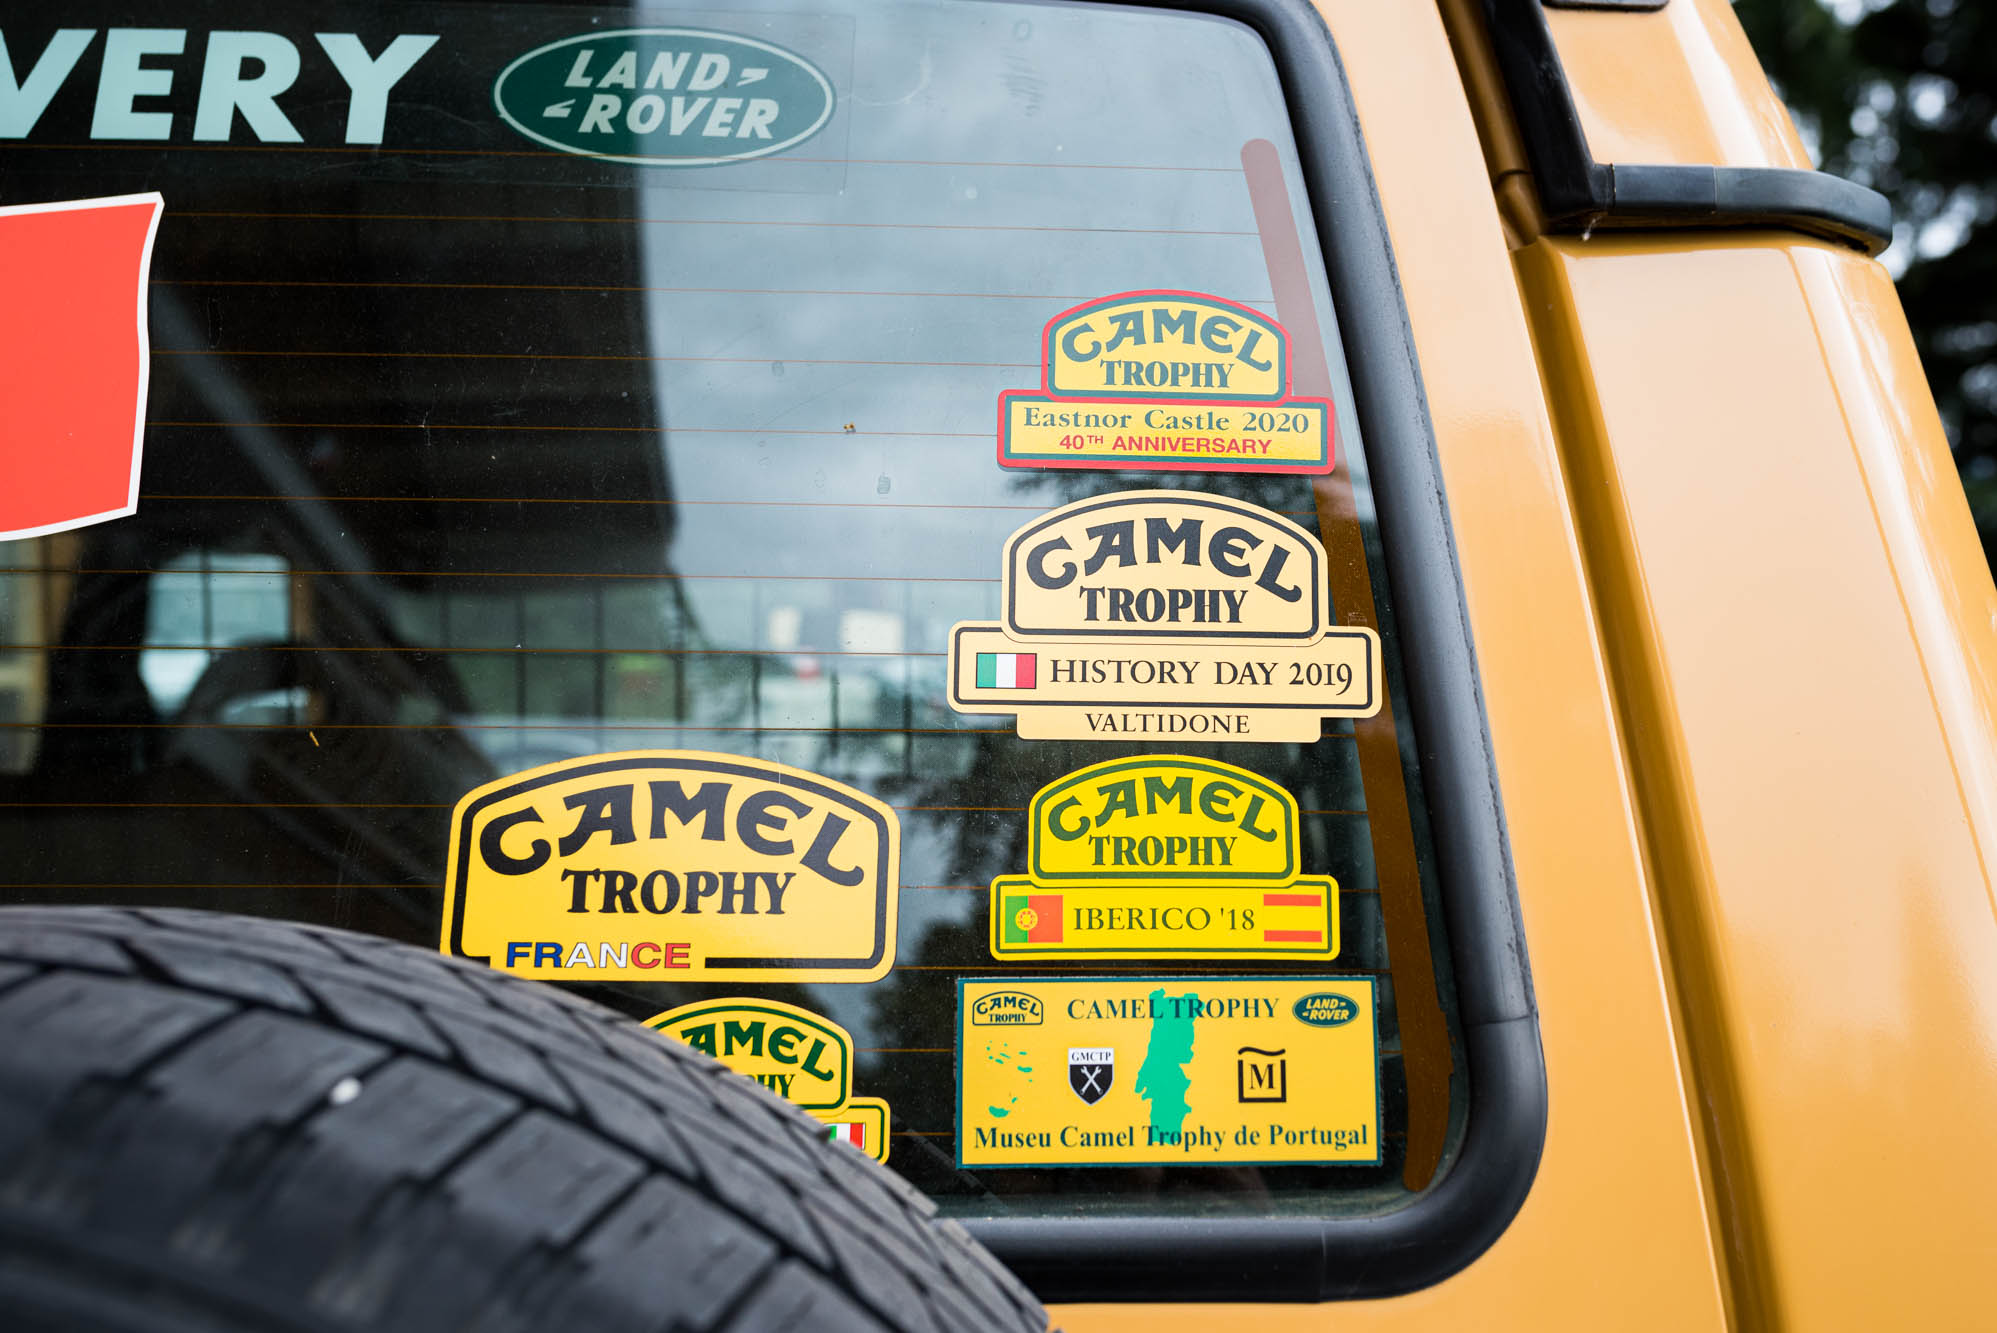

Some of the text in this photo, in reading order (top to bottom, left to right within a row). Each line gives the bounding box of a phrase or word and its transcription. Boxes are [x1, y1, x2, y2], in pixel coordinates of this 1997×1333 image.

[564, 49, 731, 91] LAND
[577, 94, 780, 140] ROVER
[1061, 308, 1273, 373] CAMEL
[1100, 359, 1235, 389] TROPHY
[1023, 406, 1309, 433] Eastnor Castle 2020
[1059, 434, 1272, 454] 40TH ANNIVERSARY
[1026, 517, 1303, 603] CAMEL
[1079, 585, 1249, 624] TROPHY
[1050, 658, 1354, 696] HISTORY DAY 2019
[1085, 712, 1250, 735] VALTIDONE
[1048, 775, 1278, 843] CAMEL
[479, 780, 865, 887] CAMEL
[1088, 834, 1238, 867] TROPHY
[561, 868, 797, 916] TROPHY
[1073, 907, 1255, 931] IBERICO '18
[506, 941, 692, 969] FRANCE
[976, 996, 1040, 1016] CAMEL
[988, 1013, 1027, 1023] TROPHY
[1067, 998, 1280, 1020] CAMEL TROPHY
[1306, 998, 1339, 1009] LAND
[1309, 1009, 1350, 1020] ROVER
[680, 1020, 834, 1082] AMEL
[1071, 1051, 1112, 1062] GMCTP
[974, 1124, 1368, 1152] Museu Camel Trophy de Portugal
